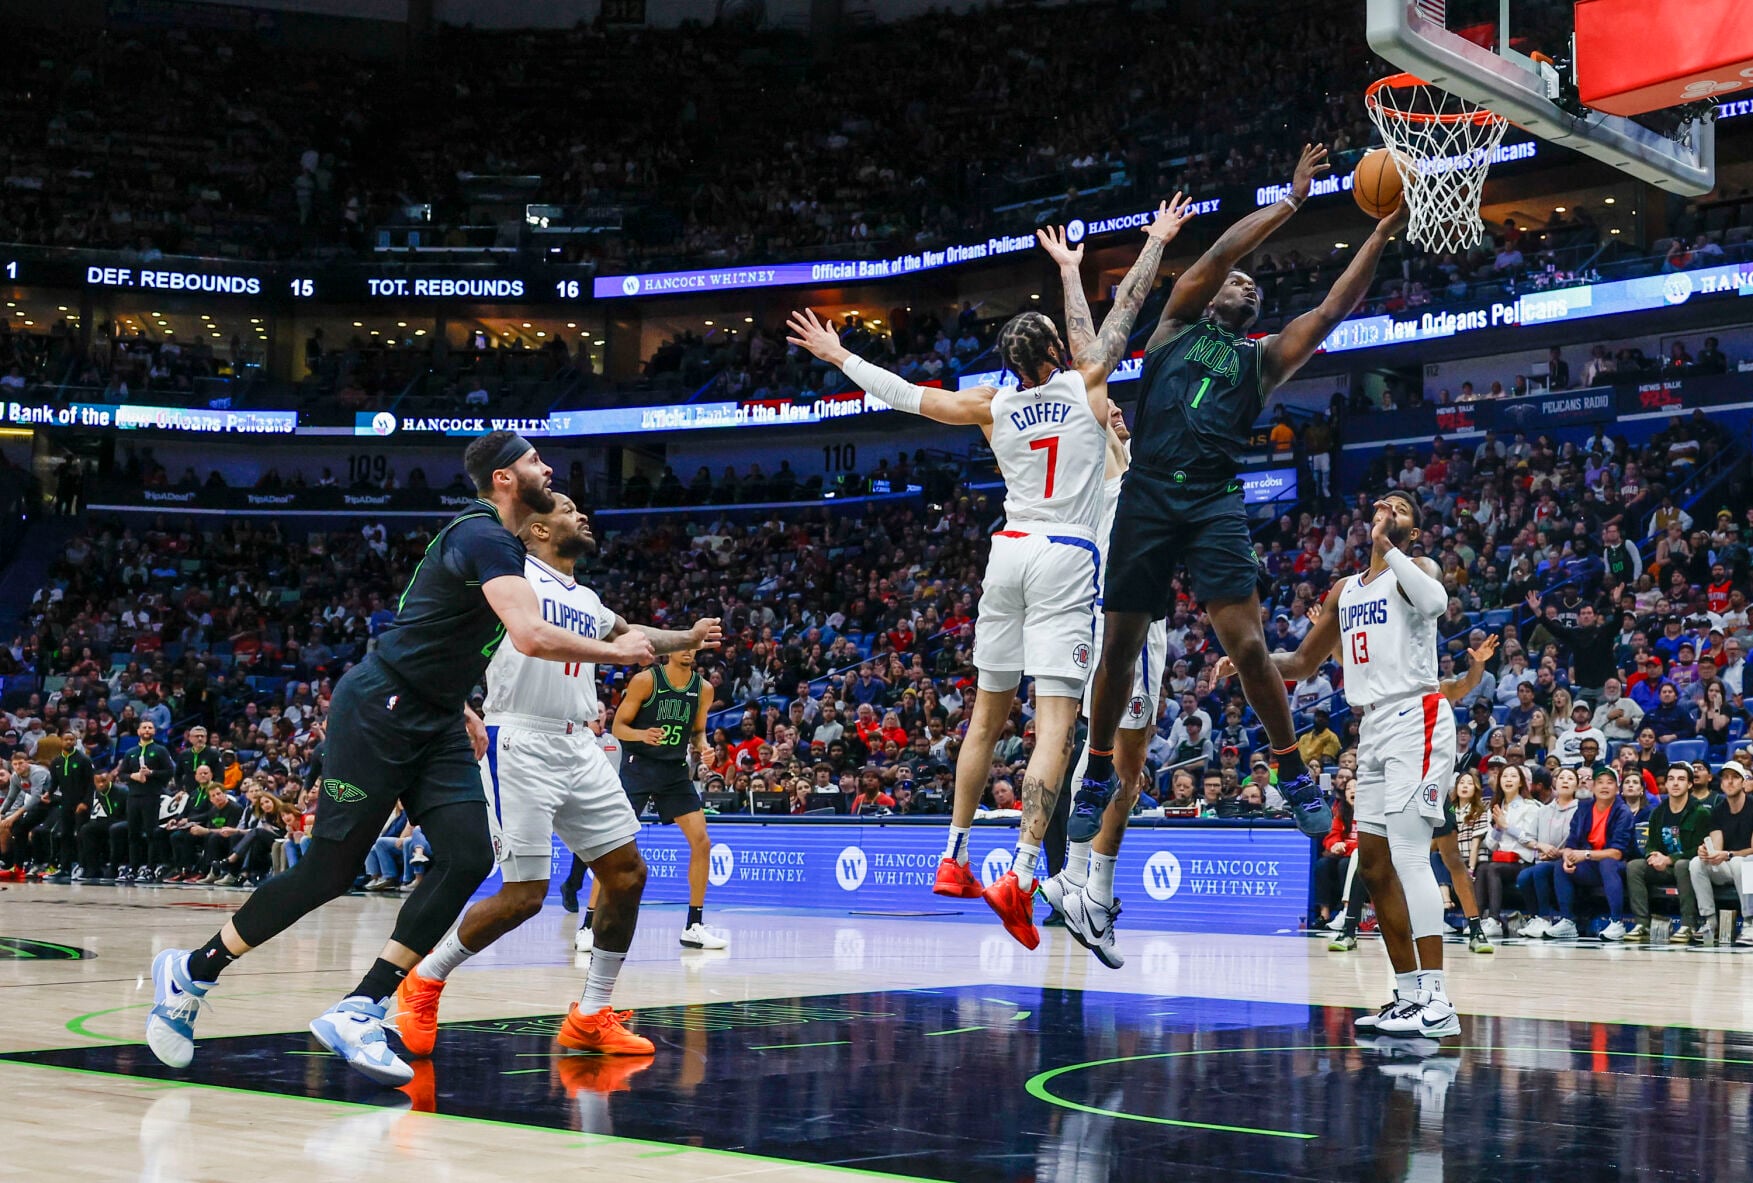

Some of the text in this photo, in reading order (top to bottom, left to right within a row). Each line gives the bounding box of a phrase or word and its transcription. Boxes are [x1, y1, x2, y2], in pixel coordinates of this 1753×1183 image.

[1257, 182, 1293, 205] Offici
[1088, 213, 1149, 234] HANCOCK
[812, 234, 1035, 280] Official Bank of the New Orleans Pelicans
[6, 261, 17, 279] 1
[87, 266, 260, 294] DEF. REBOUNDS
[644, 270, 776, 290] HANCOCK WHITNEY
[291, 279, 314, 297] 15
[368, 279, 524, 297] TOT. REBOUNDS
[556, 280, 579, 298] 16
[1422, 309, 1487, 335] Orleans
[1491, 298, 1568, 326] Pelicans
[1184, 336, 1239, 386] NOLA
[1190, 377, 1211, 408] 1
[734, 403, 750, 422] of
[752, 402, 776, 422] the
[780, 401, 811, 421] New
[814, 397, 861, 419] Orleans
[1542, 398, 1581, 414] PELICANS
[1584, 395, 1608, 408] RADIO
[9, 402, 53, 424] Bank
[58, 405, 77, 424] of
[82, 407, 109, 426] the
[115, 409, 149, 429] New
[156, 411, 221, 432] Orleans
[402, 418, 485, 431] HANCOCK
[1010, 402, 1072, 431] COFFEY
[348, 456, 386, 481] 109
[824, 443, 856, 472] 110
[1029, 436, 1059, 499] 7
[440, 495, 476, 505] TripAD
[543, 598, 597, 639] CLIPPERS
[1341, 598, 1387, 632] CLIPPERS
[1352, 631, 1370, 664] 13
[656, 699, 691, 724] NOLA
[661, 724, 683, 745] 25
[740, 850, 805, 865] HANCOCK
[1190, 859, 1279, 876] HANCOCK
[740, 867, 803, 882] WHITNEY
[874, 871, 935, 886] WHITNE
[1189, 879, 1278, 896] WHITNEY
